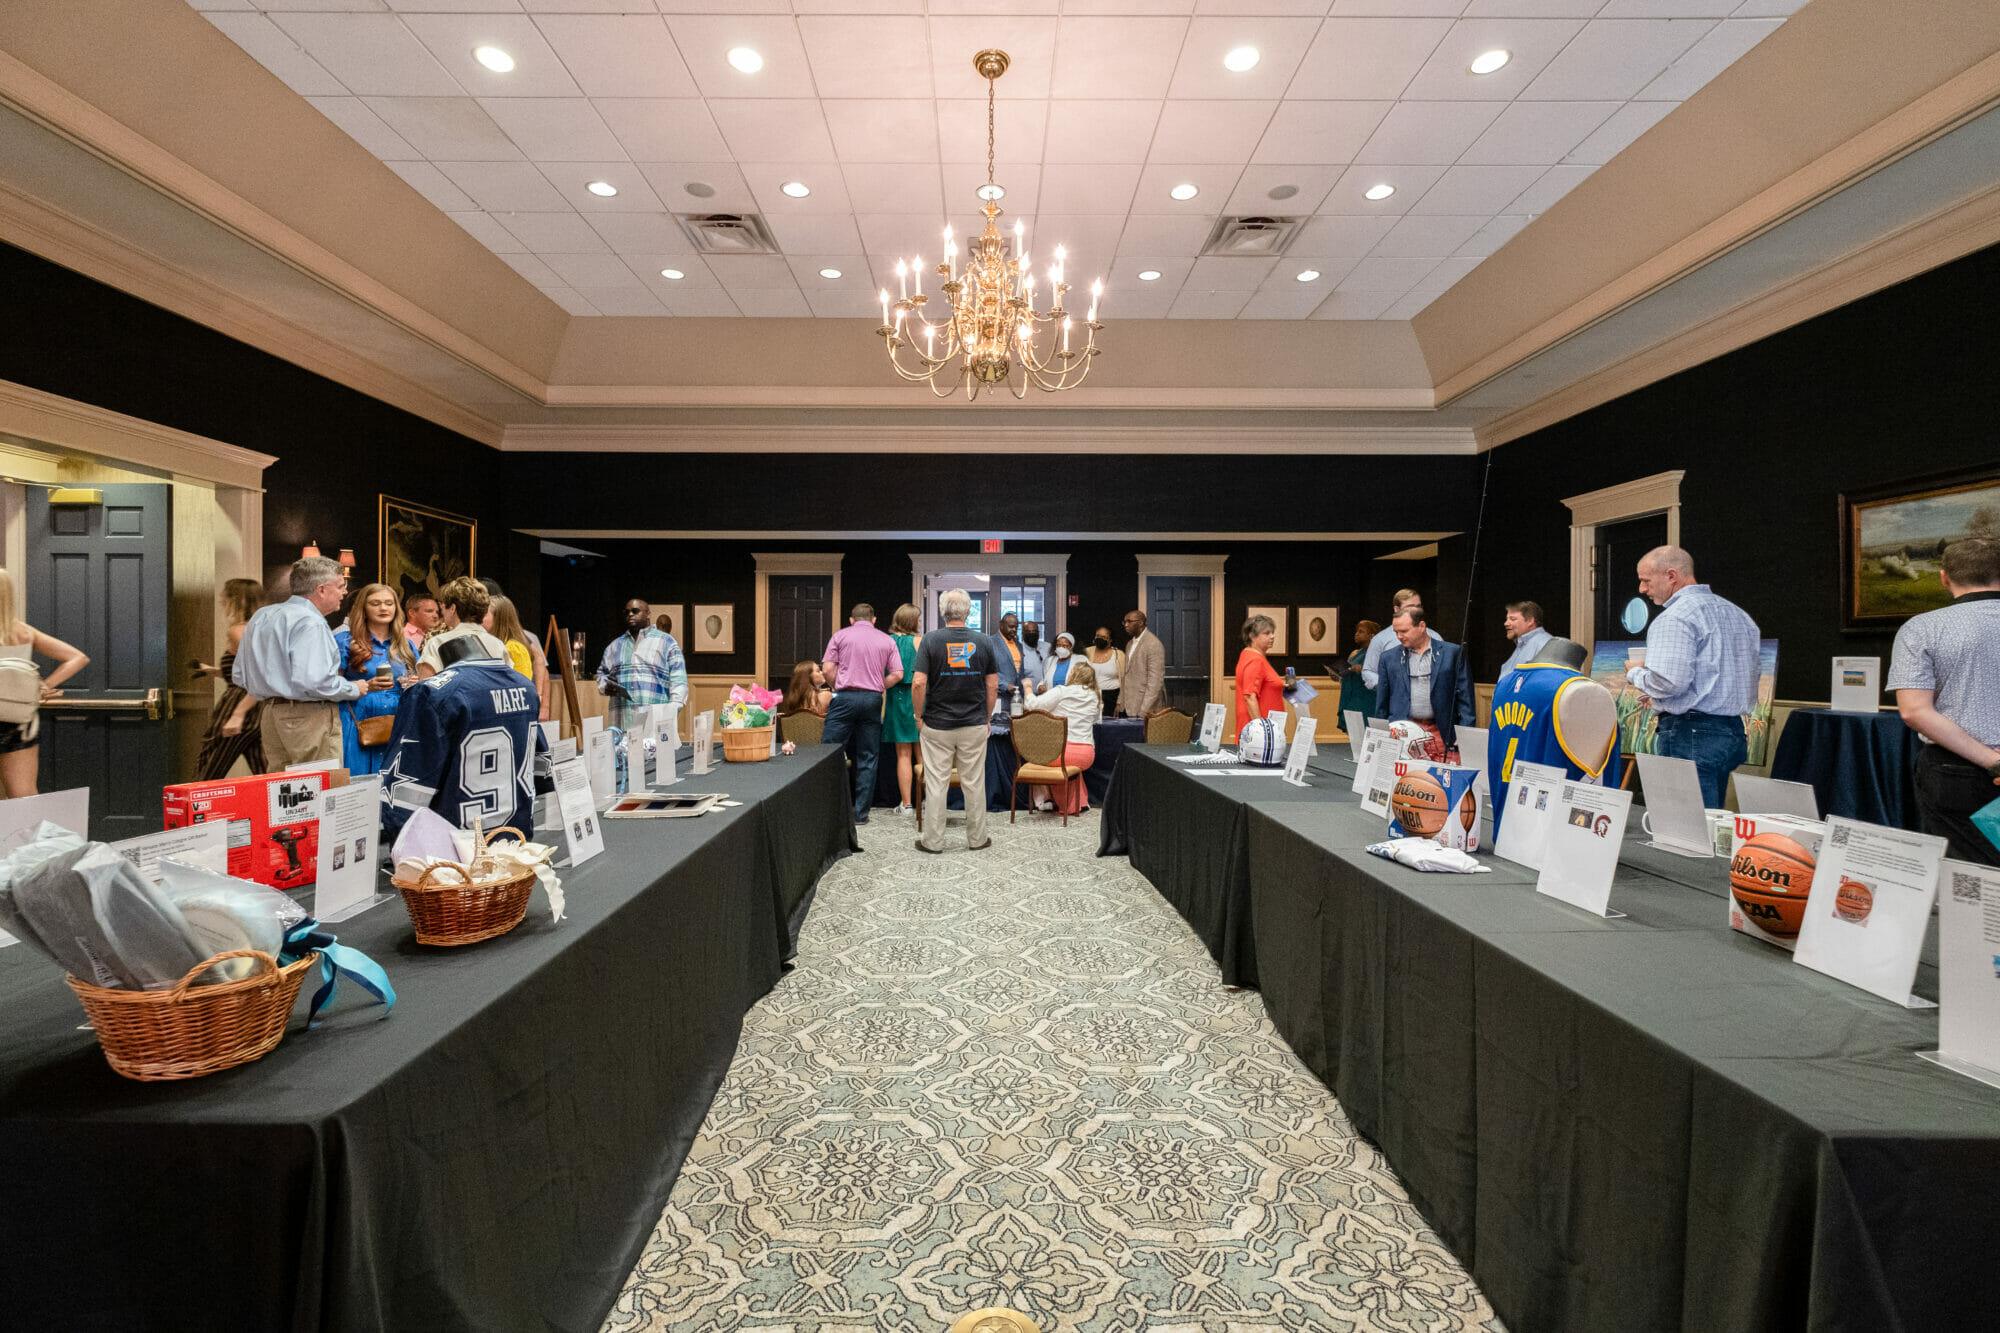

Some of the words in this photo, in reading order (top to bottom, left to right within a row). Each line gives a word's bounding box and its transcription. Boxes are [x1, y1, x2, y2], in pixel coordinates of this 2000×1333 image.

[984, 539, 1000, 553] EXIT
[490, 687, 530, 714] WARE
[1494, 701, 1534, 731] MOODY
[193, 788, 233, 799] CRAFTSMAN
[1740, 900, 1784, 921] CAA
